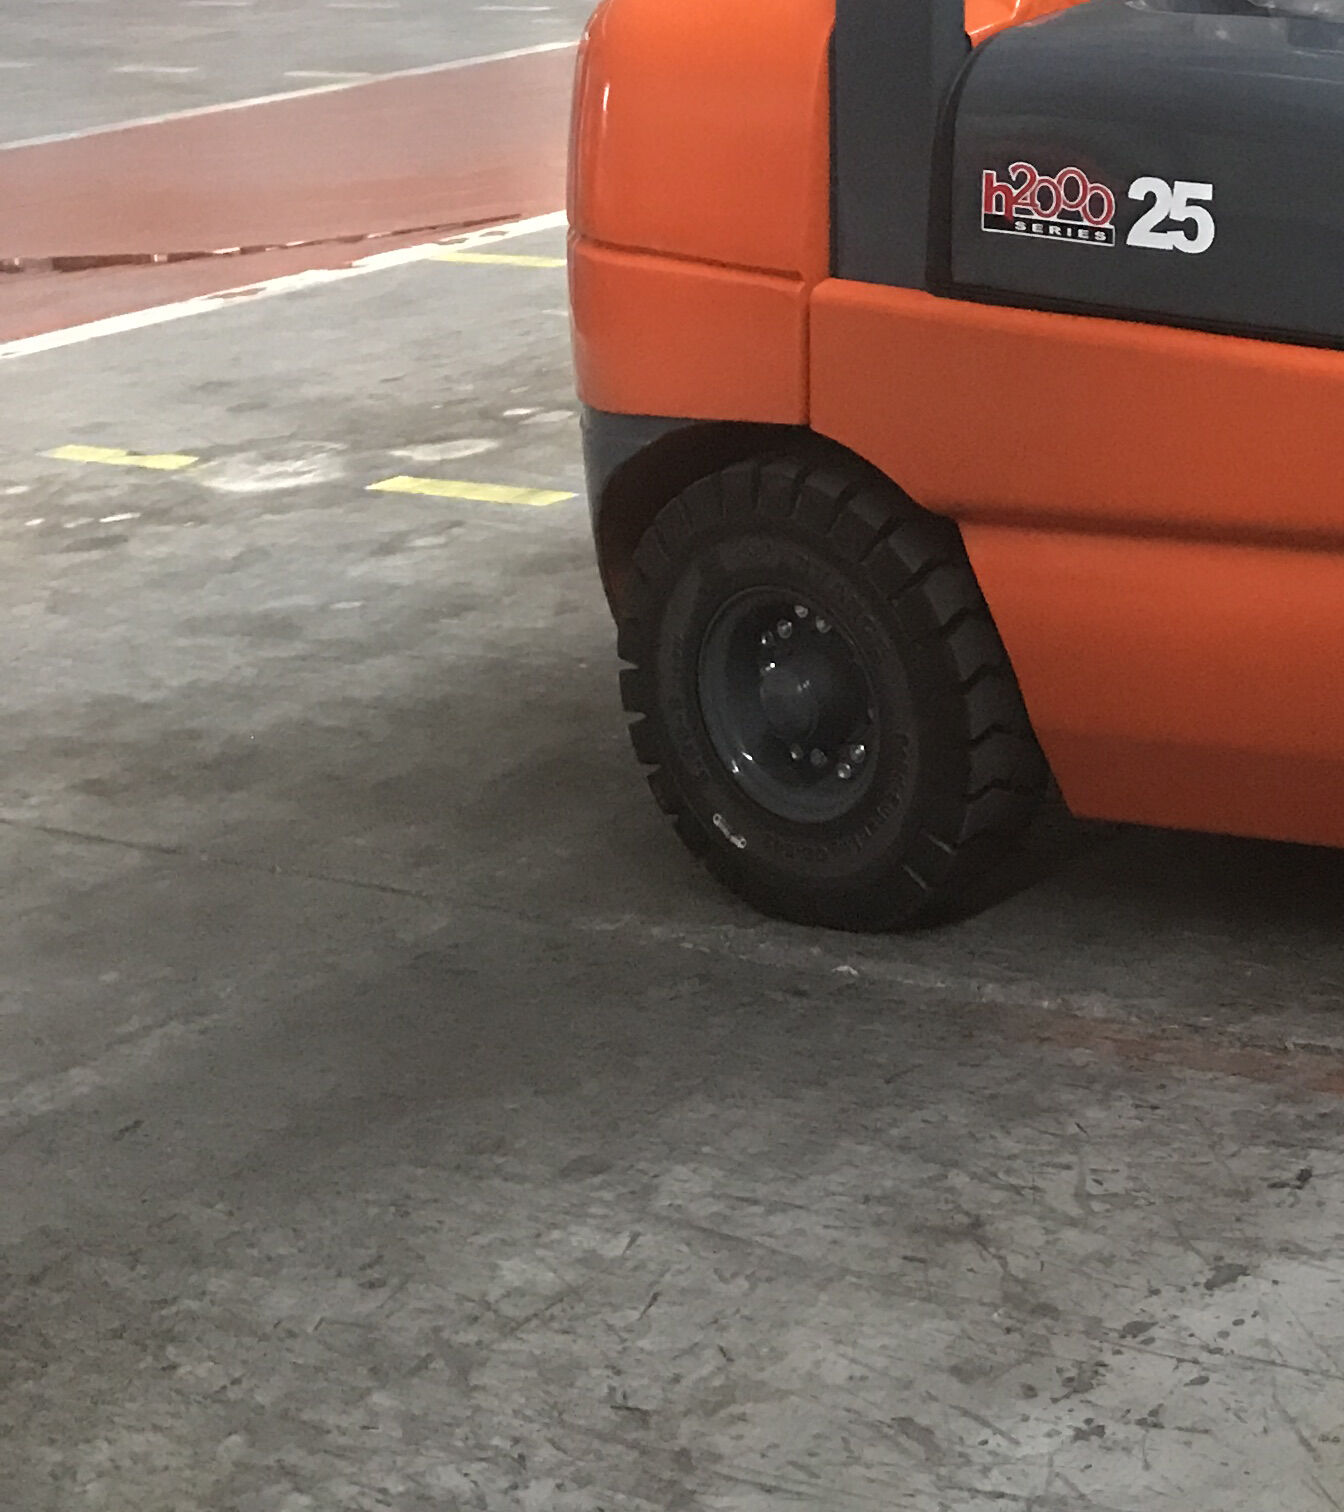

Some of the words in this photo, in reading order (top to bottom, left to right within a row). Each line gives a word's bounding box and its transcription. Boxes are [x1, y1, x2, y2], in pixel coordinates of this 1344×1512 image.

[981, 161, 1115, 227] h2000
[1126, 176, 1216, 254] 25
[1013, 220, 1109, 242] SERIES
